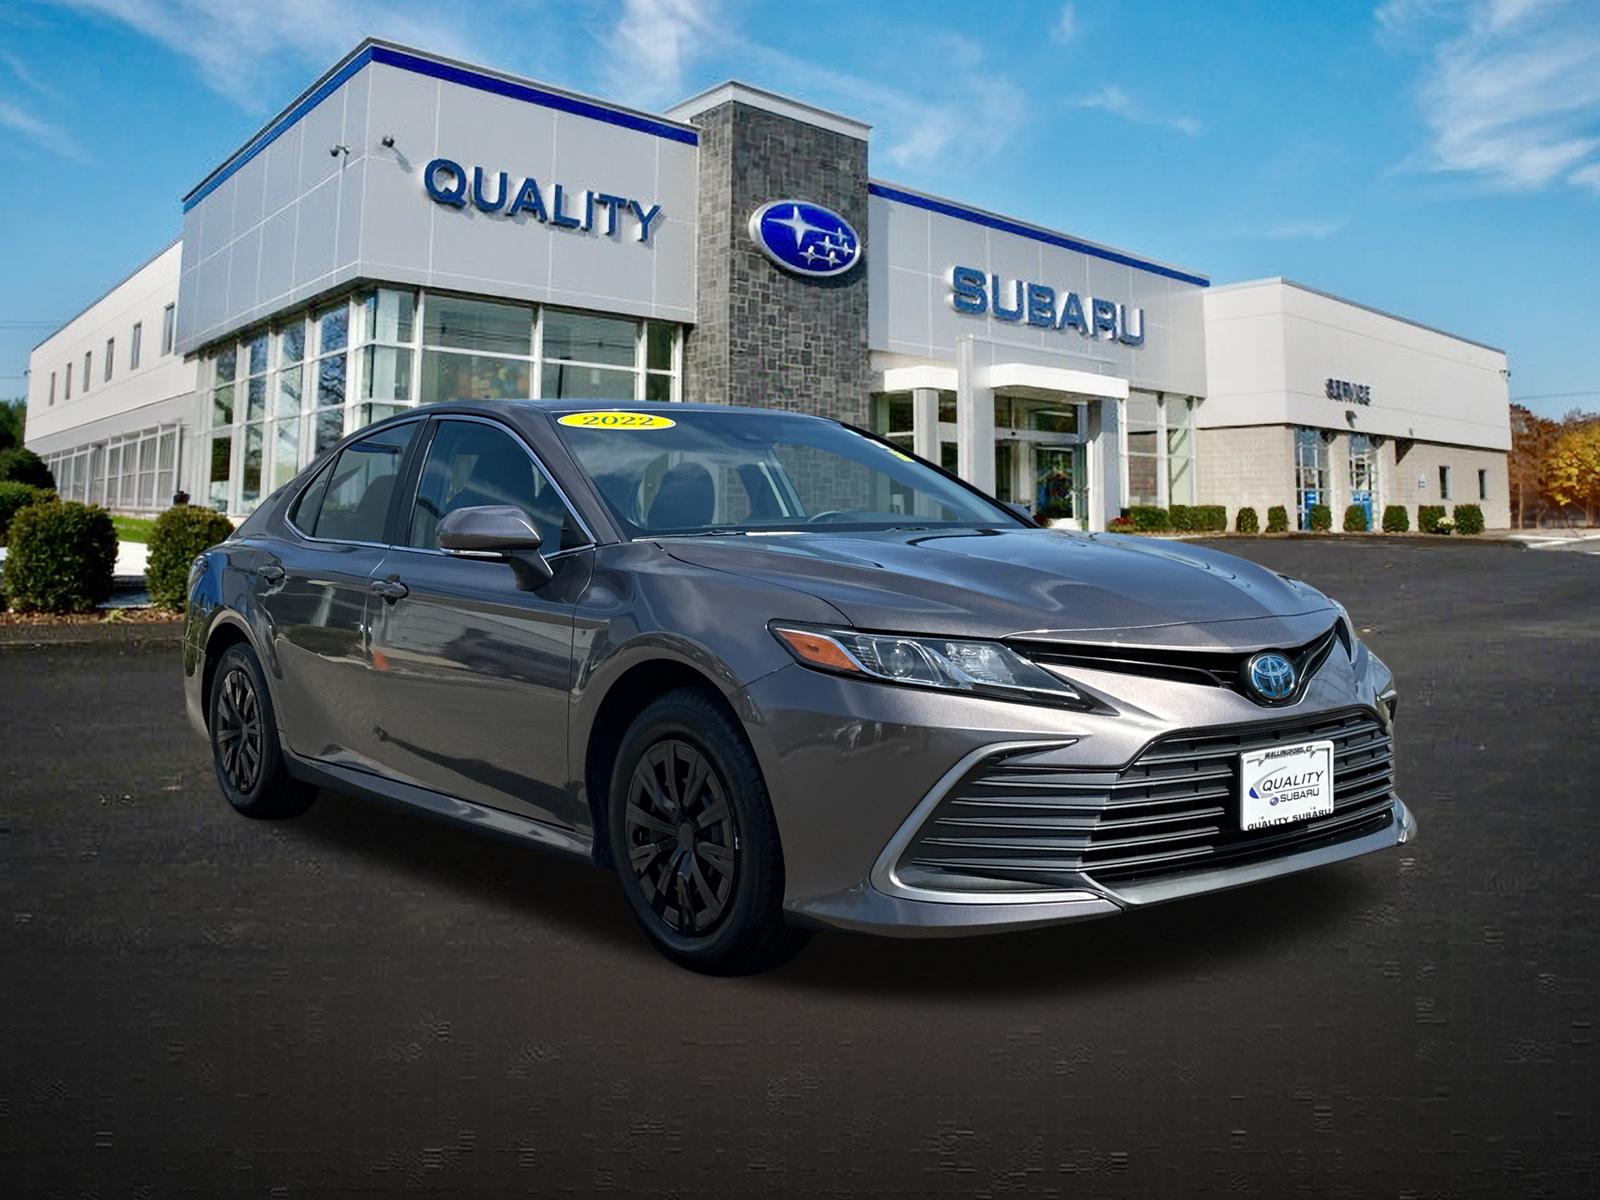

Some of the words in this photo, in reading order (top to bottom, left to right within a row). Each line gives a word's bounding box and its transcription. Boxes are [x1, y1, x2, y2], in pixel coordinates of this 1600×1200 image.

[424, 158, 662, 243] QUALITY
[951, 265, 1145, 347] SUBARU
[1326, 378, 1371, 407] SERVICE
[582, 415, 655, 426] 2022
[1262, 770, 1324, 792] QUALITY
[1280, 788, 1320, 803] SUBARU
[1247, 816, 1289, 830] QUALITY
[1292, 808, 1332, 822] SUBARU
